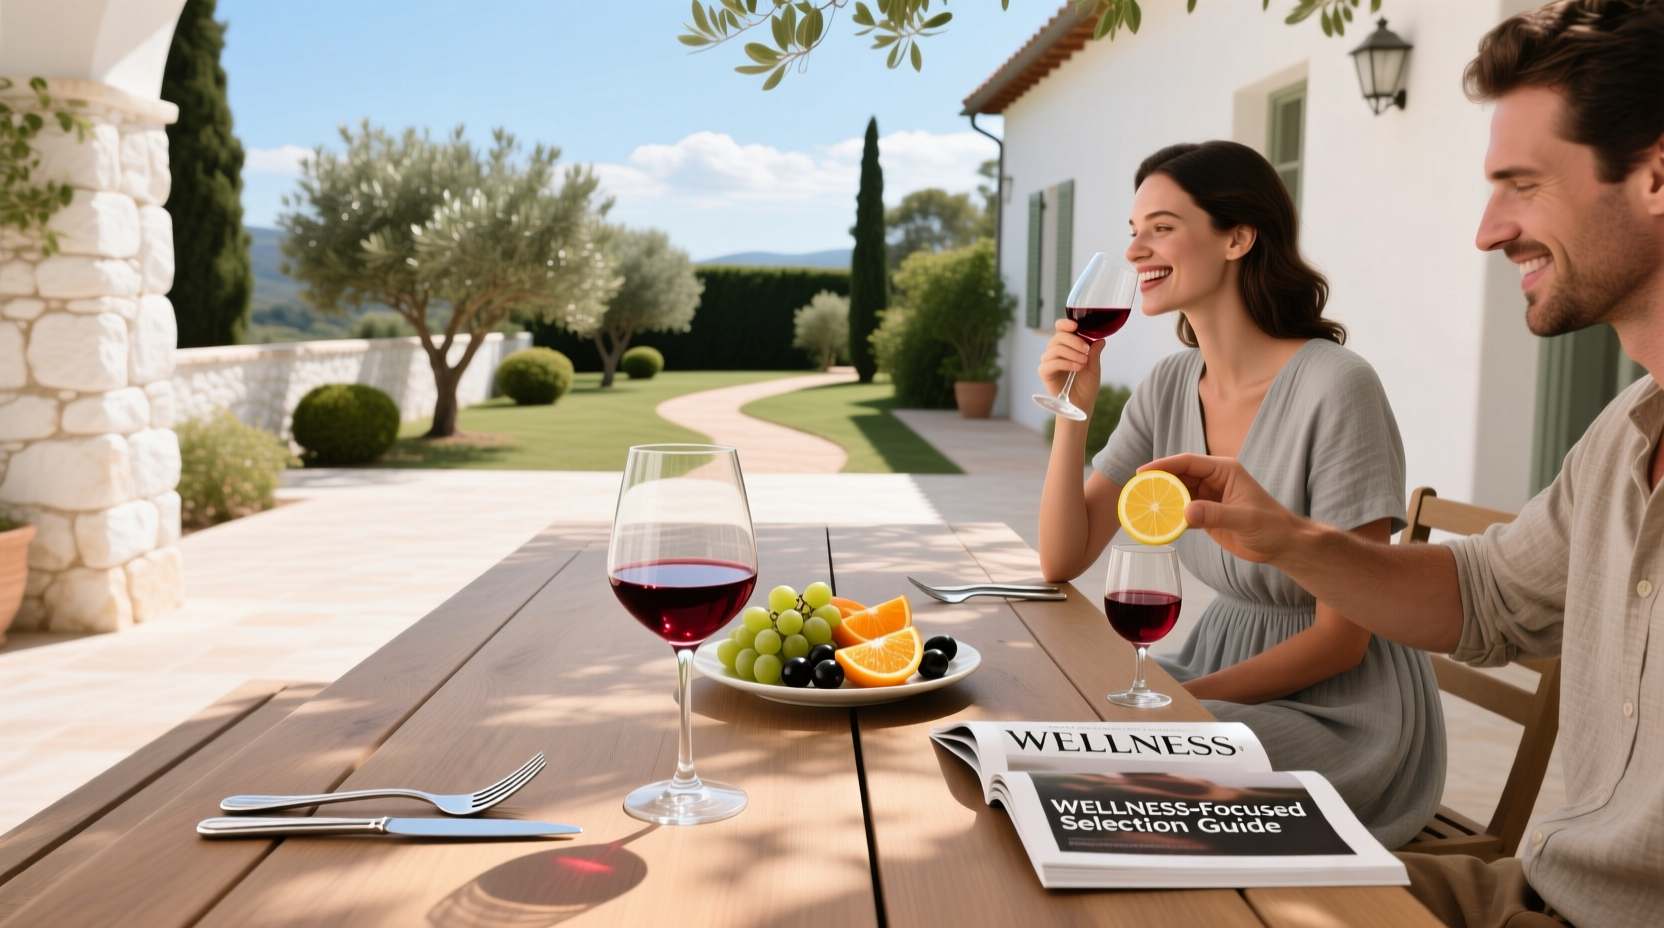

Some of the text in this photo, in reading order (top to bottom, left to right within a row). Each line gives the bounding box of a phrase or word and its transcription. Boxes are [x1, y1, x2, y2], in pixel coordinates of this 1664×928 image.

[1005, 729, 1237, 756] WELLNESS
[1050, 798, 1307, 817] WELLNESS-Focused
[1060, 815, 1282, 834] Selection Guide
